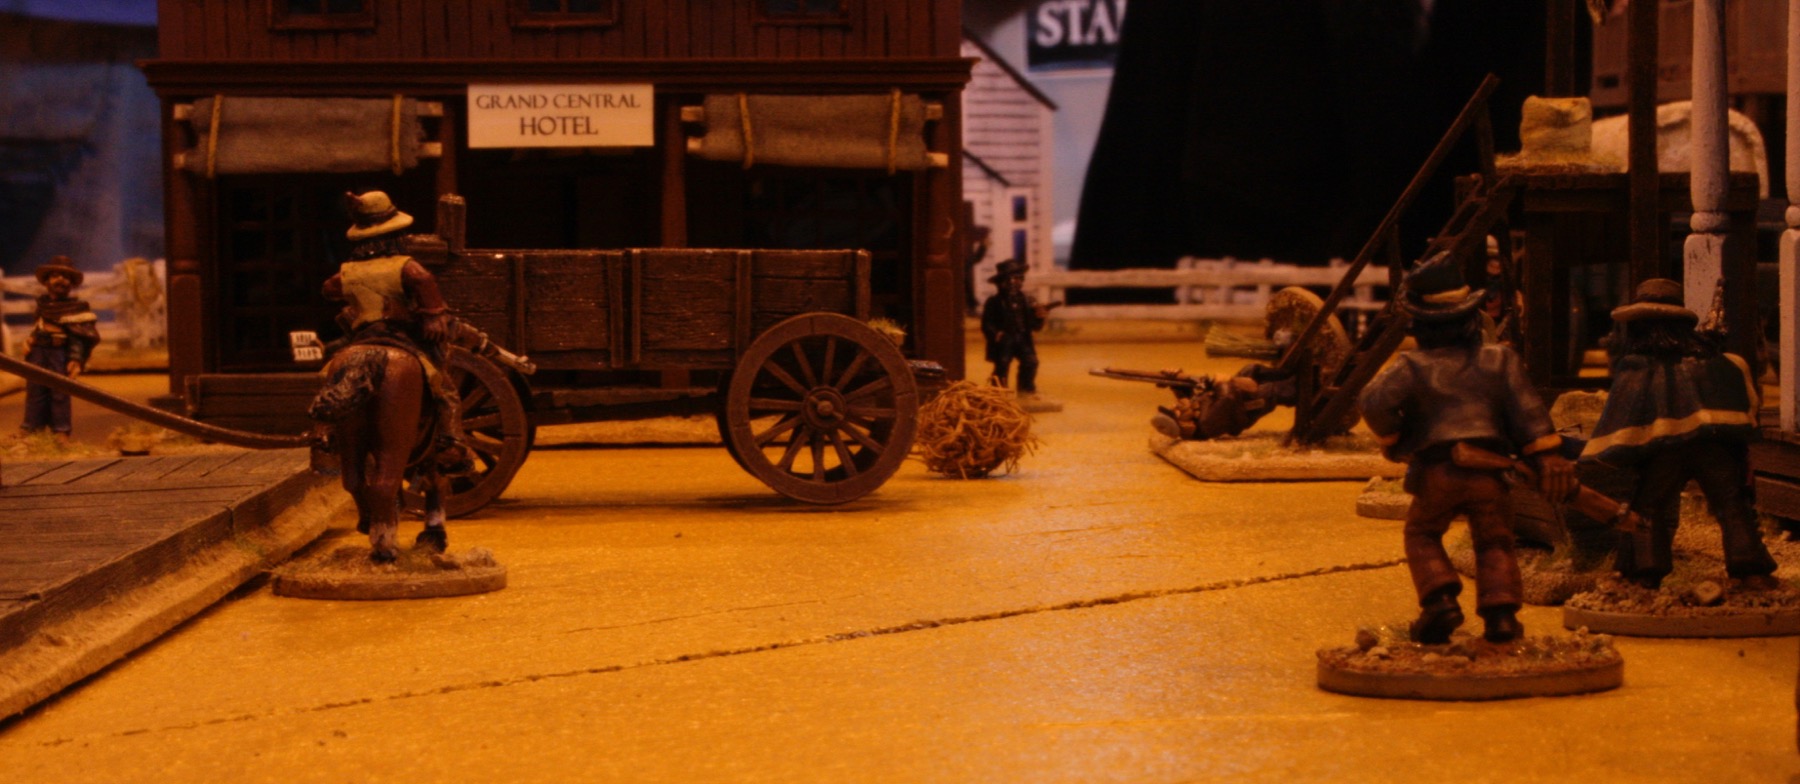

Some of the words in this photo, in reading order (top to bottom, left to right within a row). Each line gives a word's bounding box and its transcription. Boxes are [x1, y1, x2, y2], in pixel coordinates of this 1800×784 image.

[476, 94, 548, 110] GRAND
[553, 93, 641, 109] CENTRAL
[520, 116, 599, 136] HOTEL
